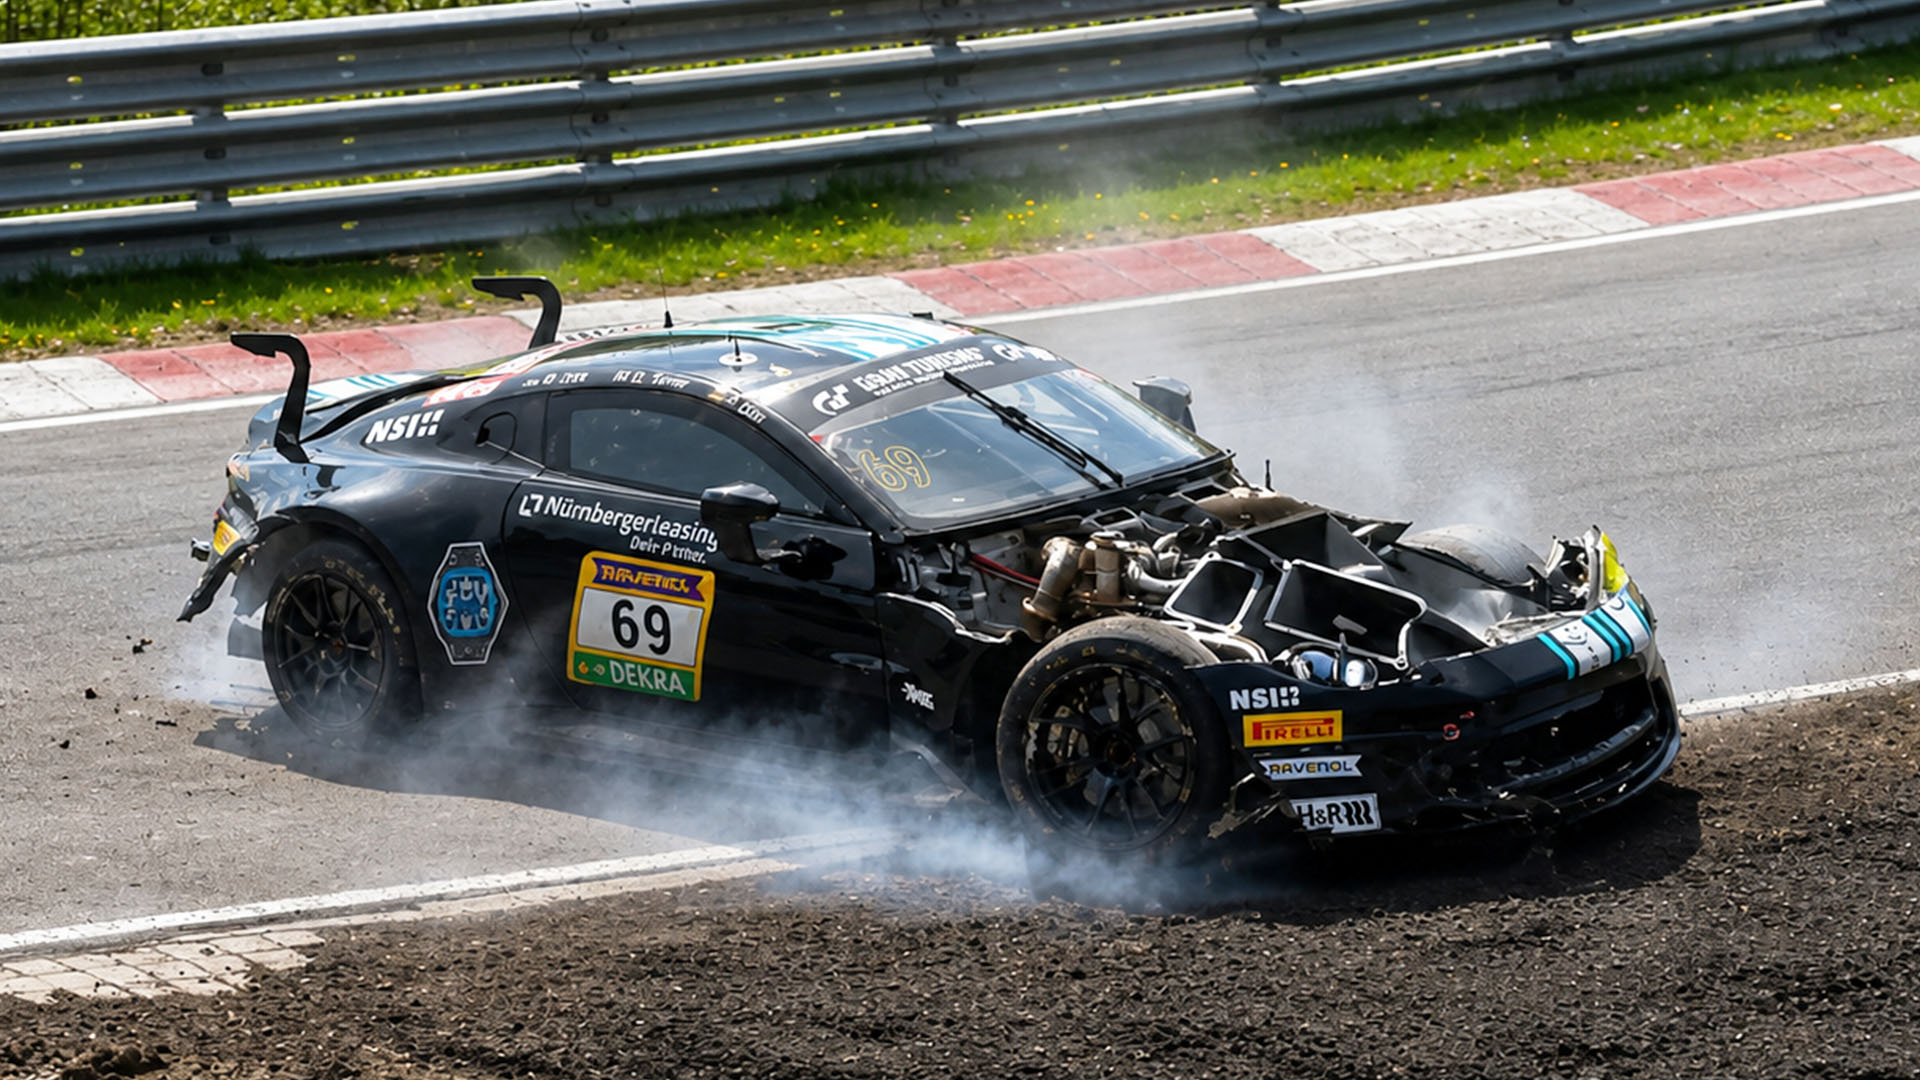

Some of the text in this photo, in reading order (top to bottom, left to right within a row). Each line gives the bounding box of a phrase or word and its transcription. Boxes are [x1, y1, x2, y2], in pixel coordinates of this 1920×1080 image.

[858, 445, 931, 492] 69
[612, 599, 671, 655] 69
[609, 660, 686, 696] DEKRA
[1252, 717, 1335, 740] PIRELLI
[1269, 760, 1353, 775] RAVENOL
